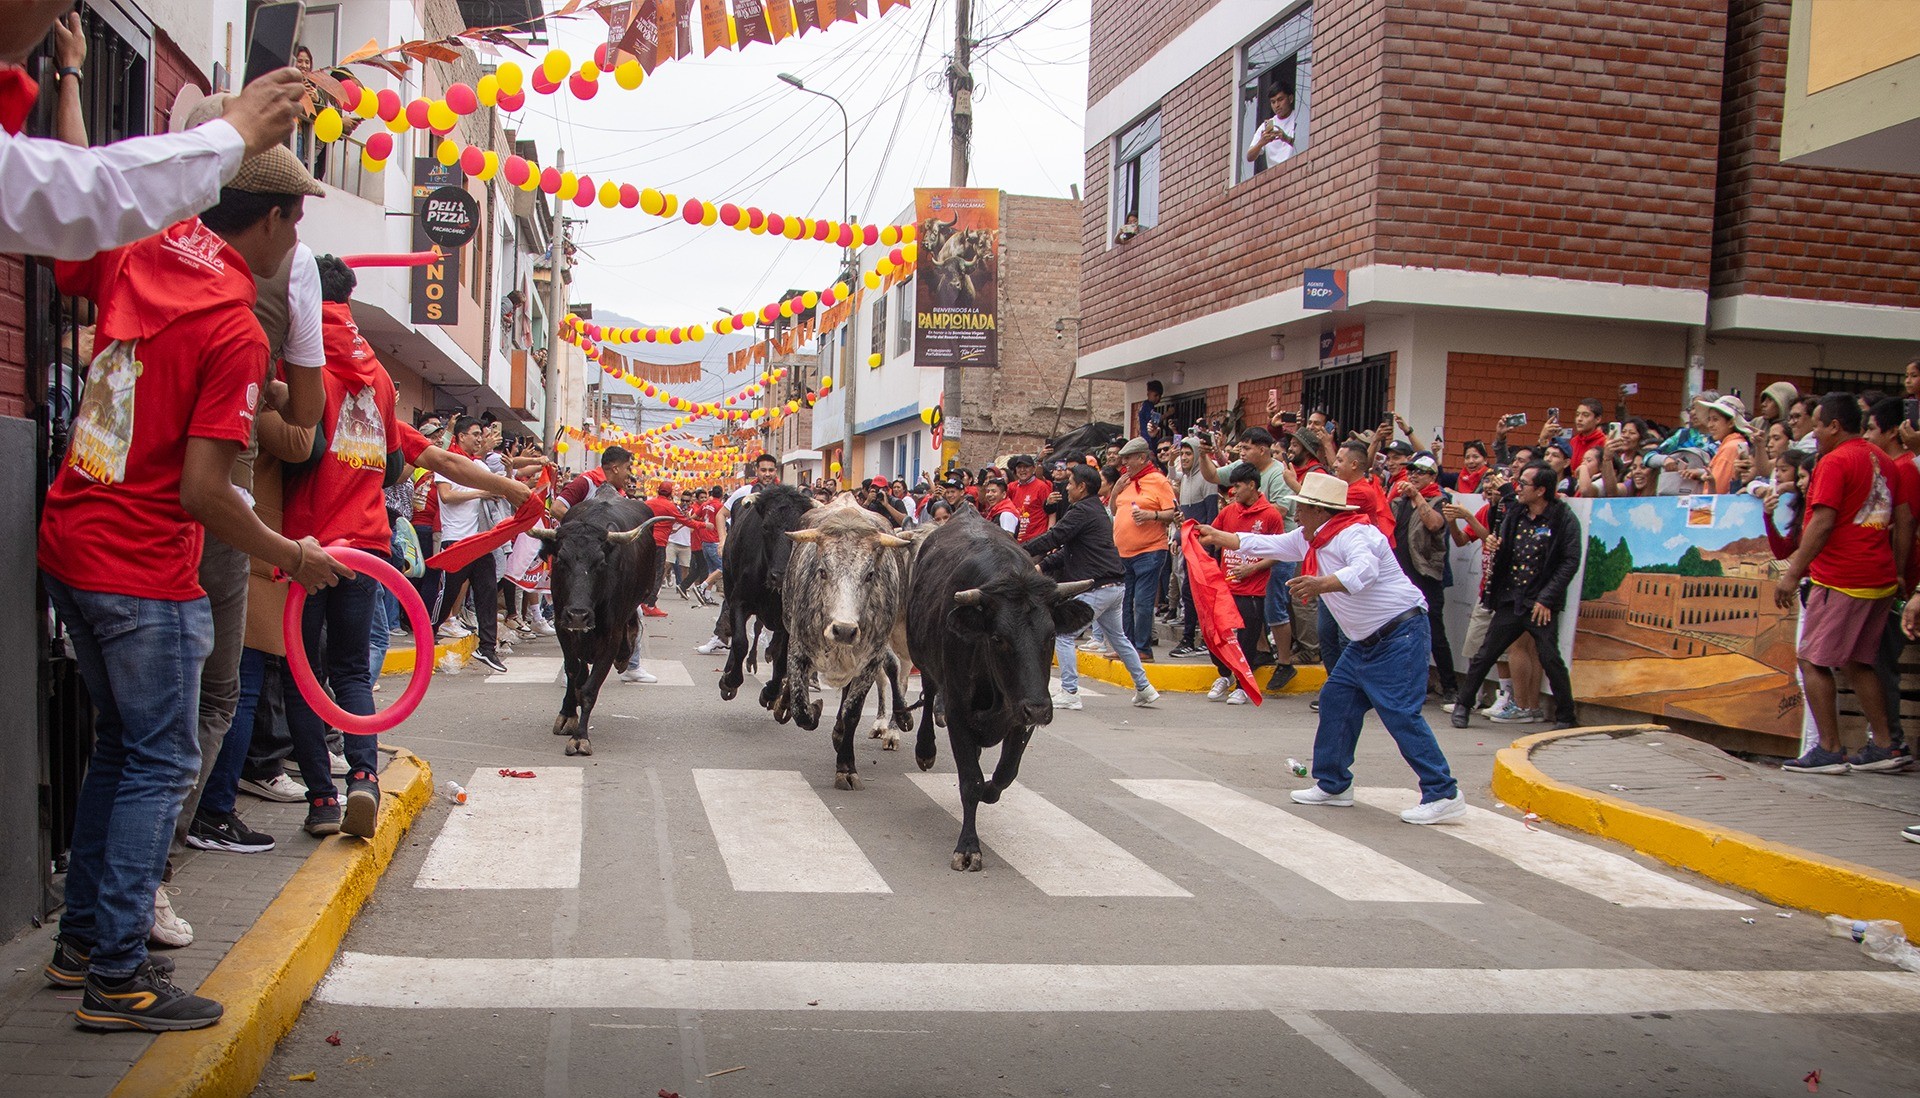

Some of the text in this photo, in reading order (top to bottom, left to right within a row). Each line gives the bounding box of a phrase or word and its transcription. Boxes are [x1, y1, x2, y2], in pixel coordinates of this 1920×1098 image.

[426, 244, 445, 320] ANOS
[1311, 288, 1328, 297] BCP
[67, 444, 116, 486] SARIO
